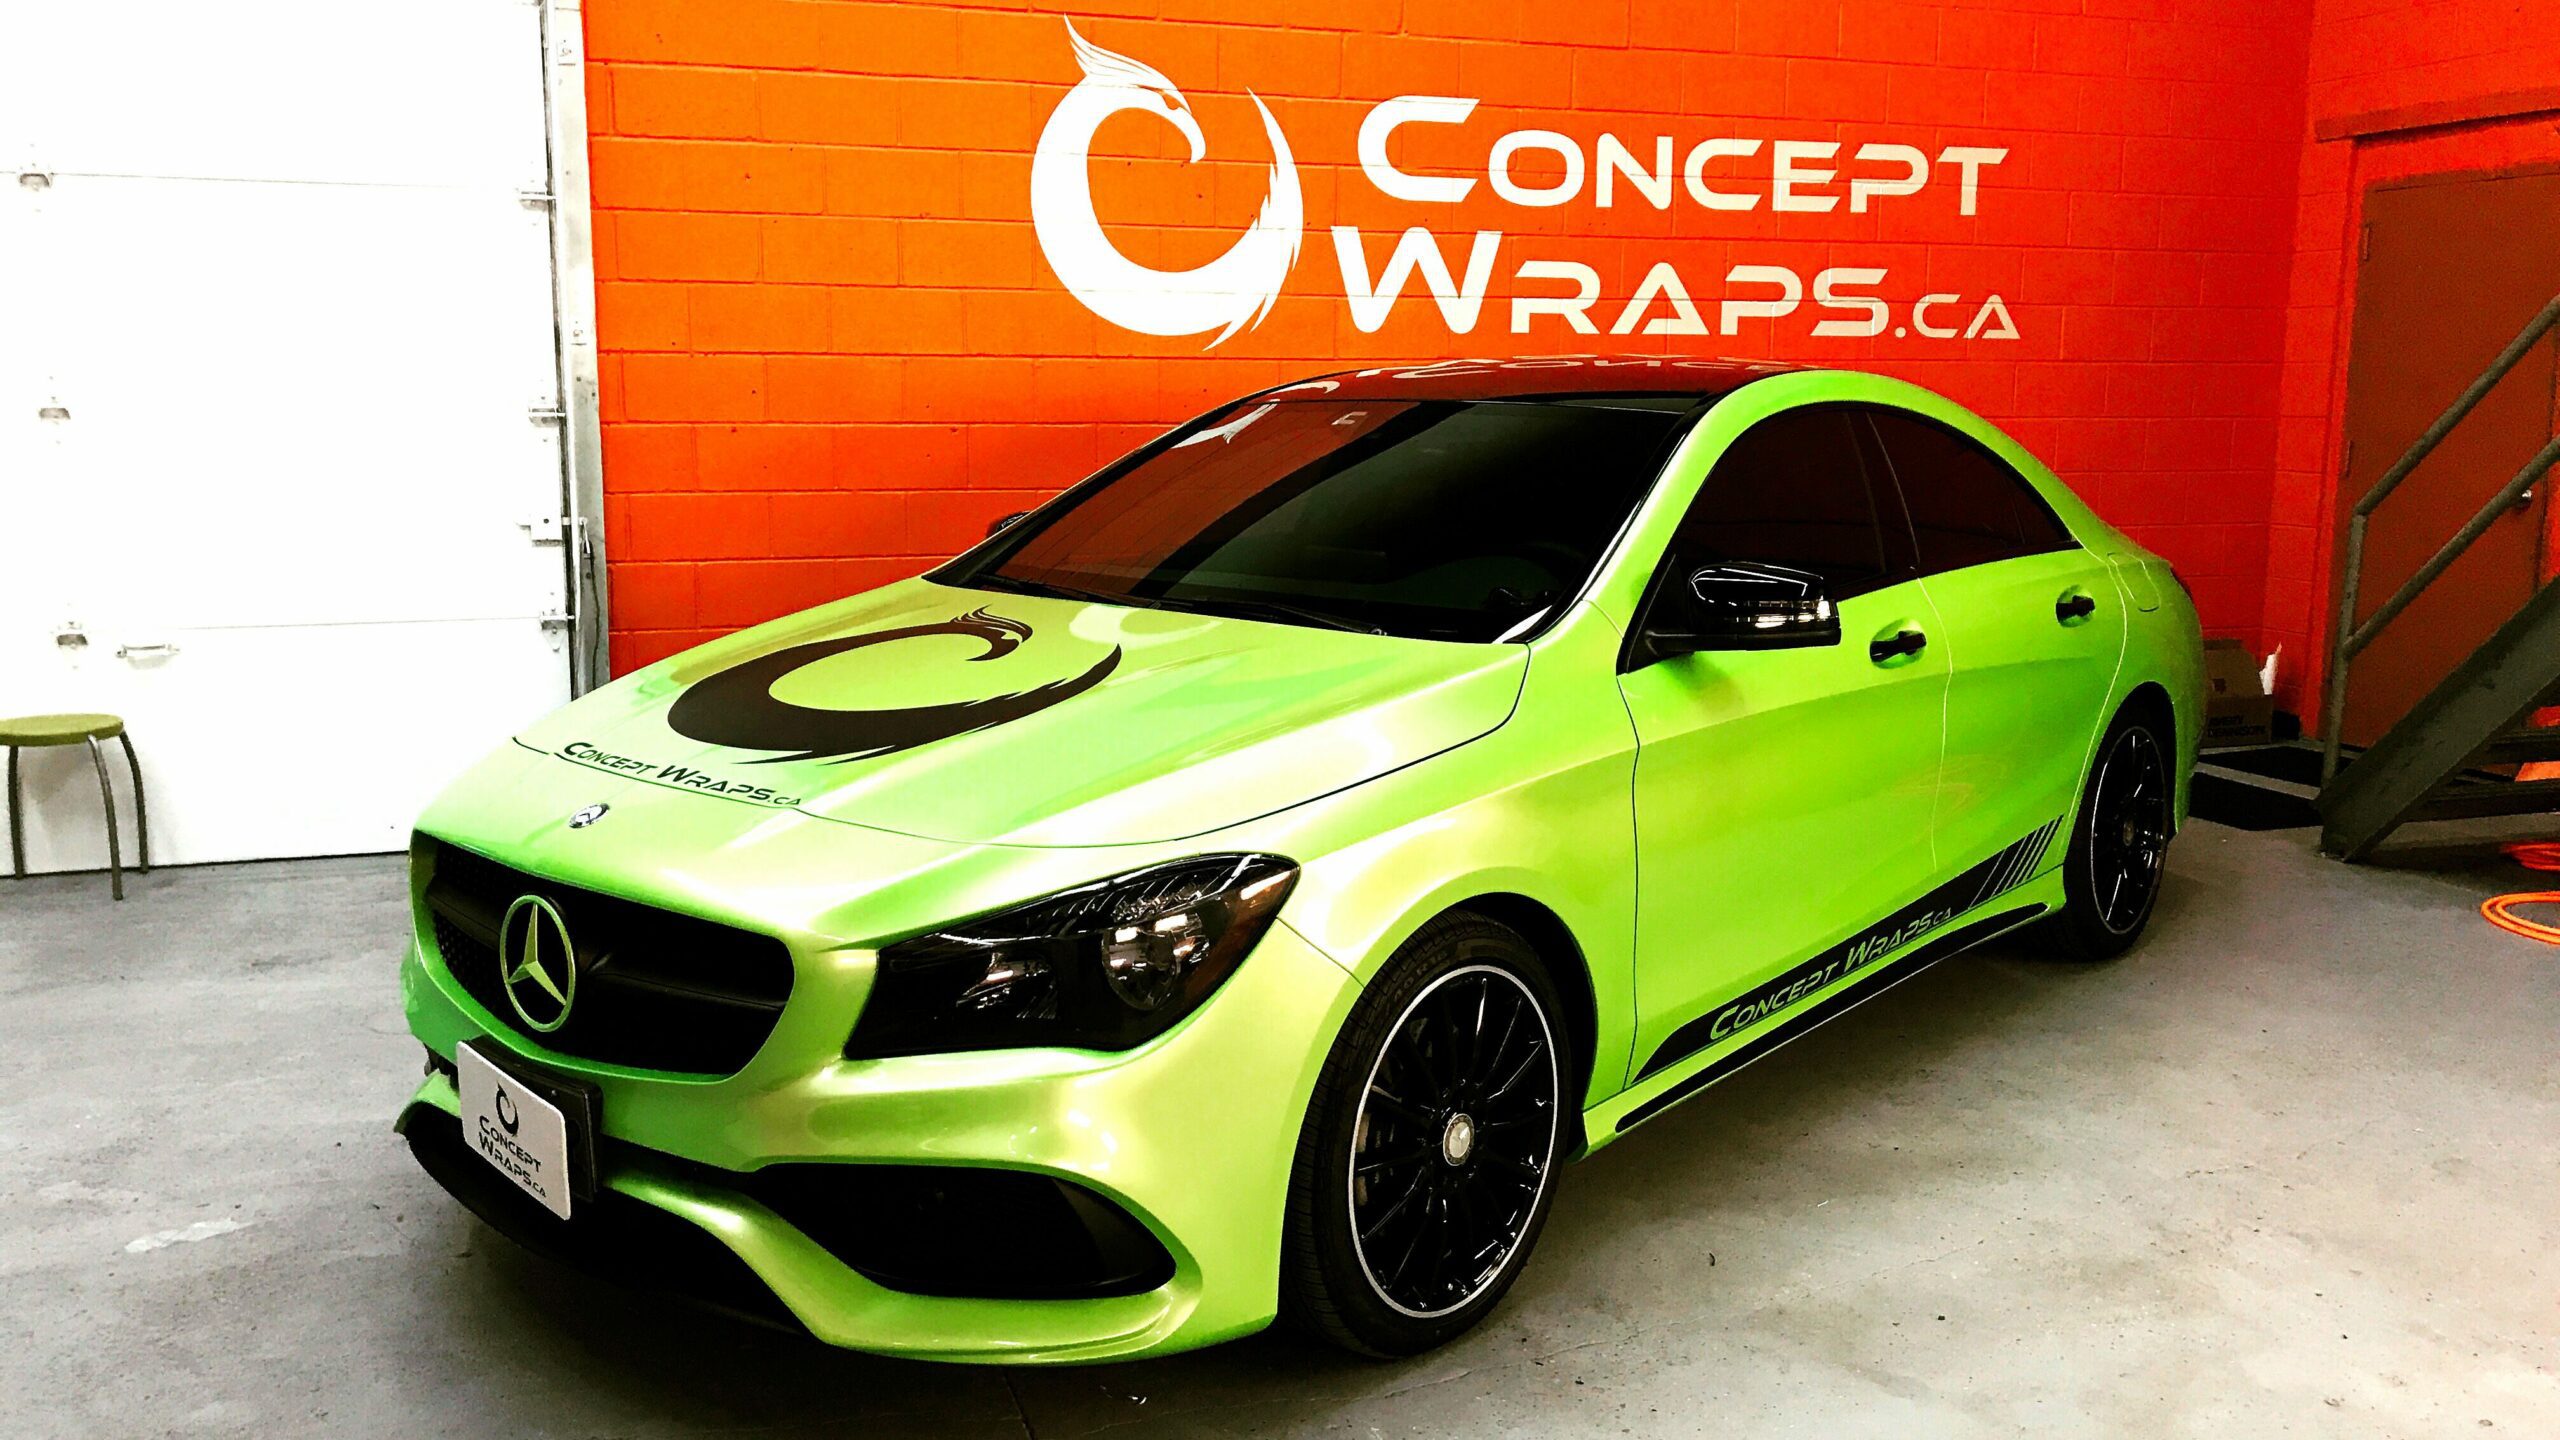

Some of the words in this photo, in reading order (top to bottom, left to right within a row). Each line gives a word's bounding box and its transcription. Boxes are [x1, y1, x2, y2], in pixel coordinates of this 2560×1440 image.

[1357, 95, 2009, 216] CONCEPT
[1330, 225, 2021, 341] WRAPS.CA
[564, 742, 658, 775] CONCEPT
[1710, 961, 1840, 1041] CONCEPT
[479, 1115, 542, 1173] CONCEPT
